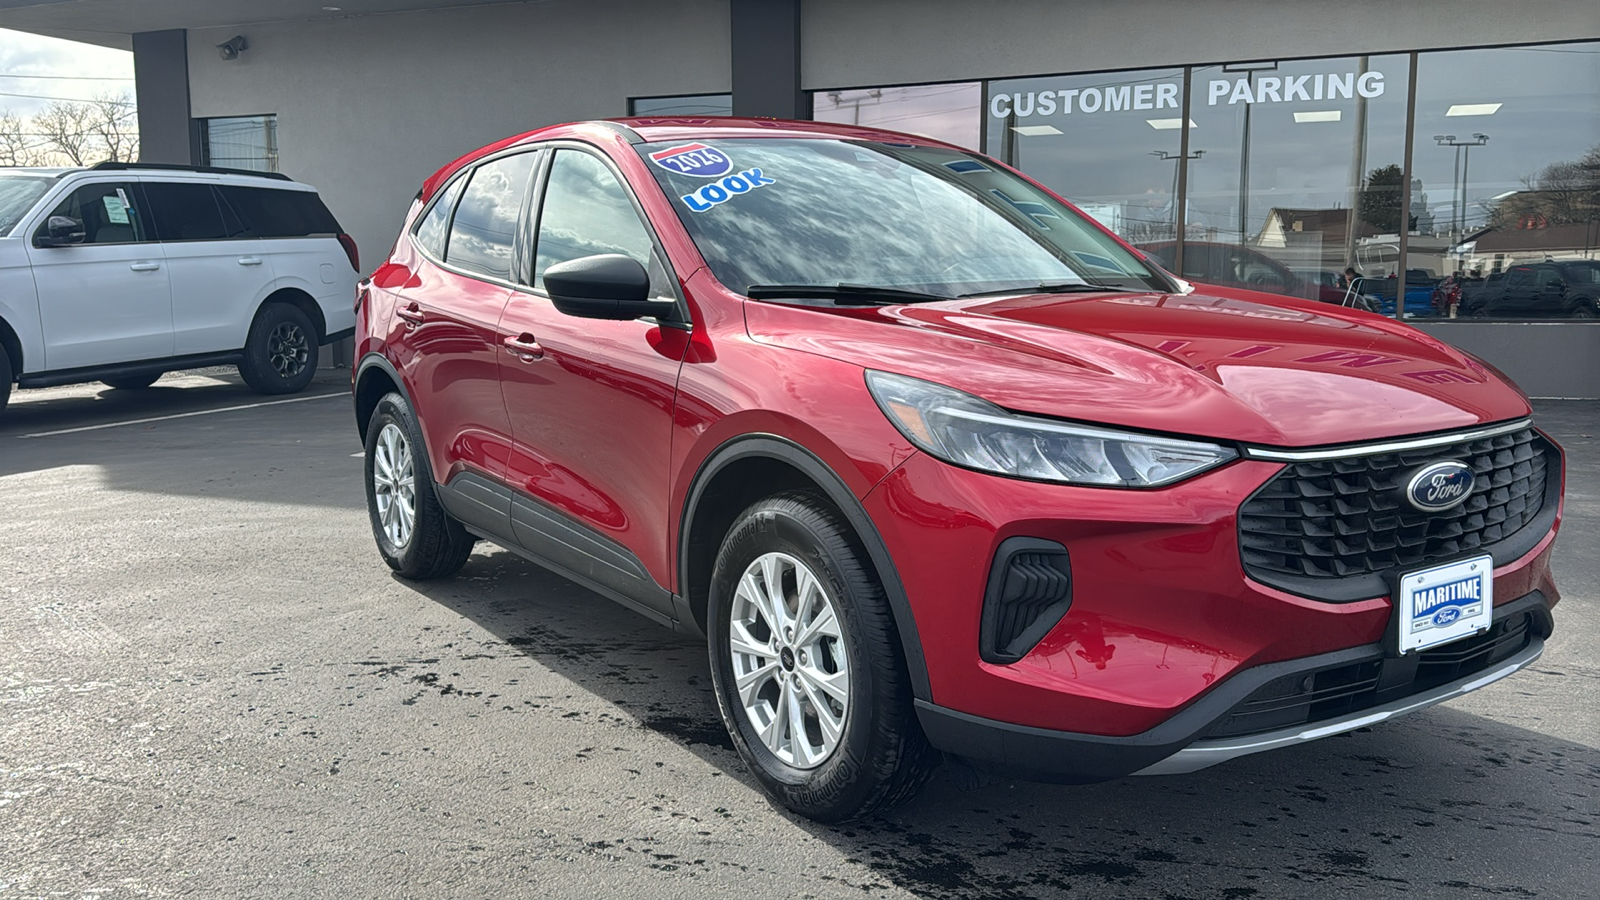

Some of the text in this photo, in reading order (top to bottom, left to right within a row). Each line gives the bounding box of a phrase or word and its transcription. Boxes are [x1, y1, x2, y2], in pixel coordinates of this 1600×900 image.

[990, 71, 1385, 119] CUSTOMER PARKING
[666, 148, 724, 172] 2026
[681, 167, 776, 212] LOOK
[1427, 472, 1464, 502] Ford
[1414, 578, 1480, 617] MARITIME
[1436, 609, 1457, 624] Ford
